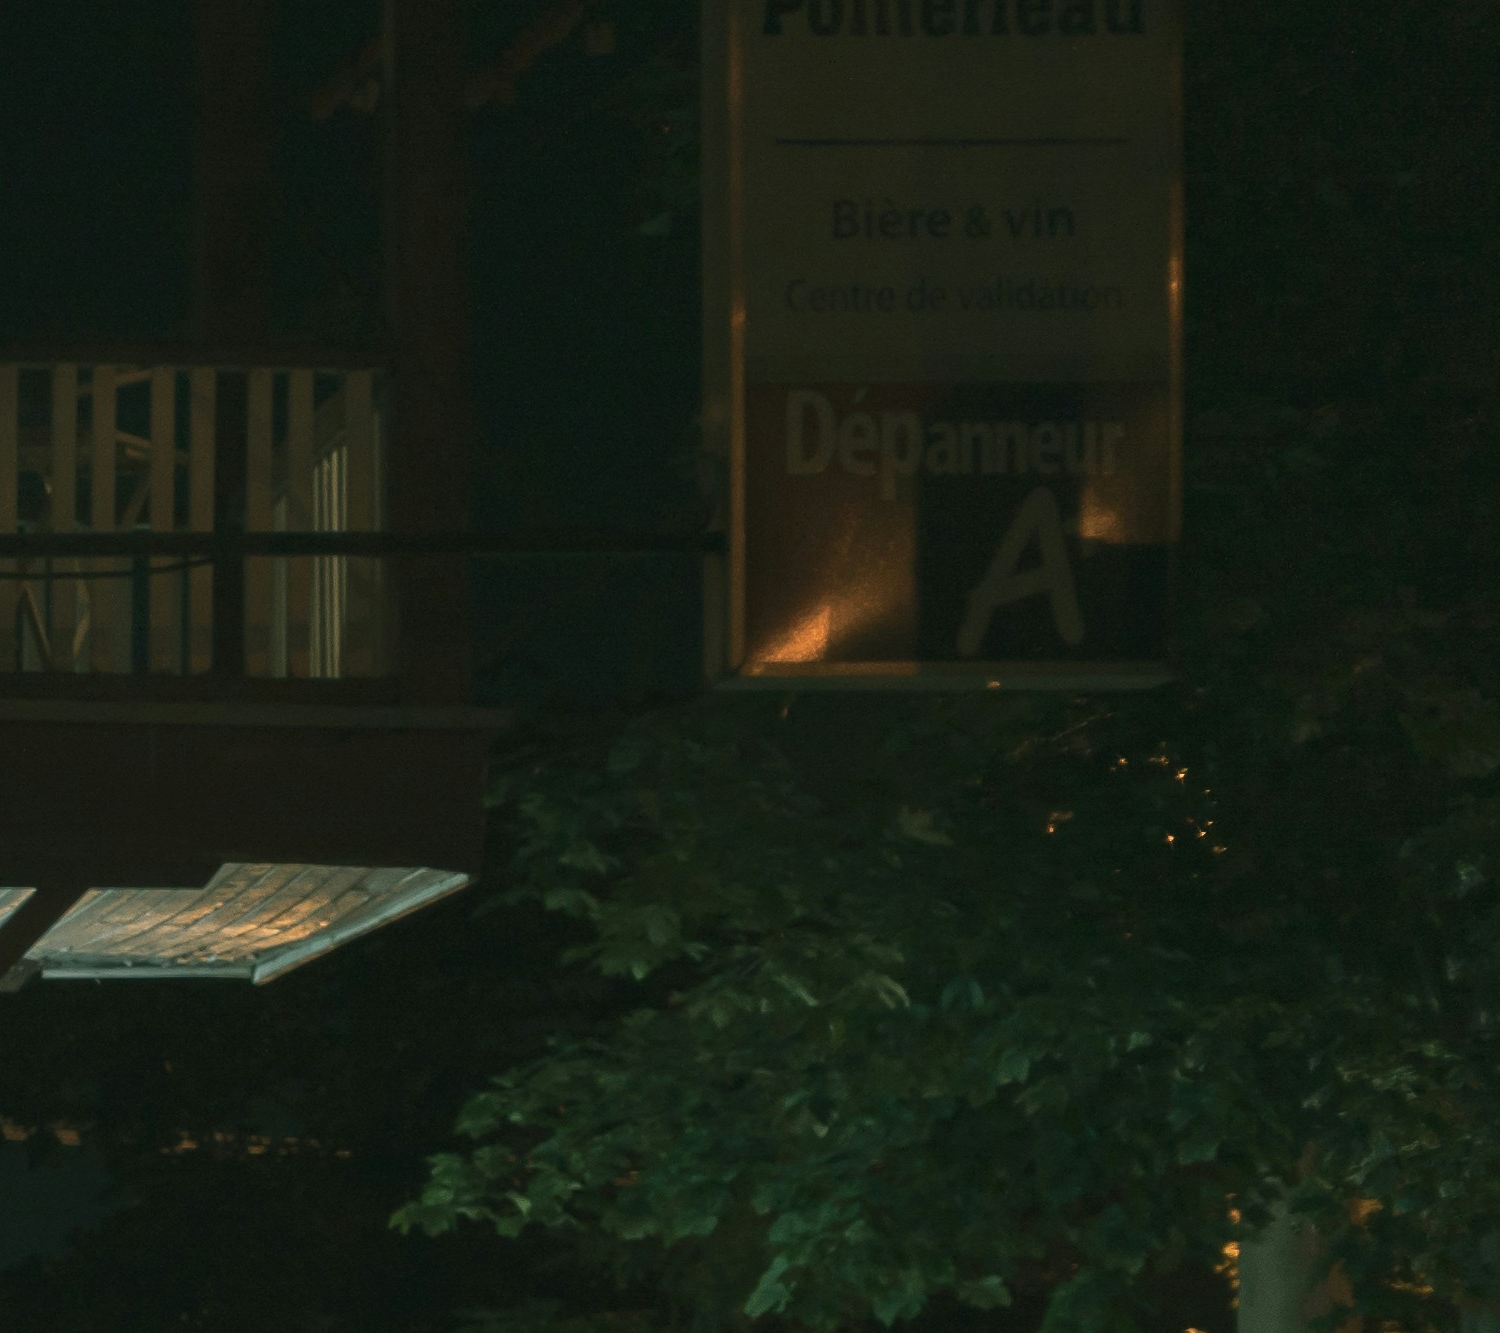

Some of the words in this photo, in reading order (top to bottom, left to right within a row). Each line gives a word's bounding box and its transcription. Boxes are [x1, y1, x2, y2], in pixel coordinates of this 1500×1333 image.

[831, 199, 952, 240] Bière
[965, 202, 988, 239] &
[1004, 200, 1076, 239] vin
[786, 278, 894, 314] Centre
[905, 277, 949, 314] de
[959, 276, 1123, 314] validation
[784, 388, 1125, 500] Dépanneur
